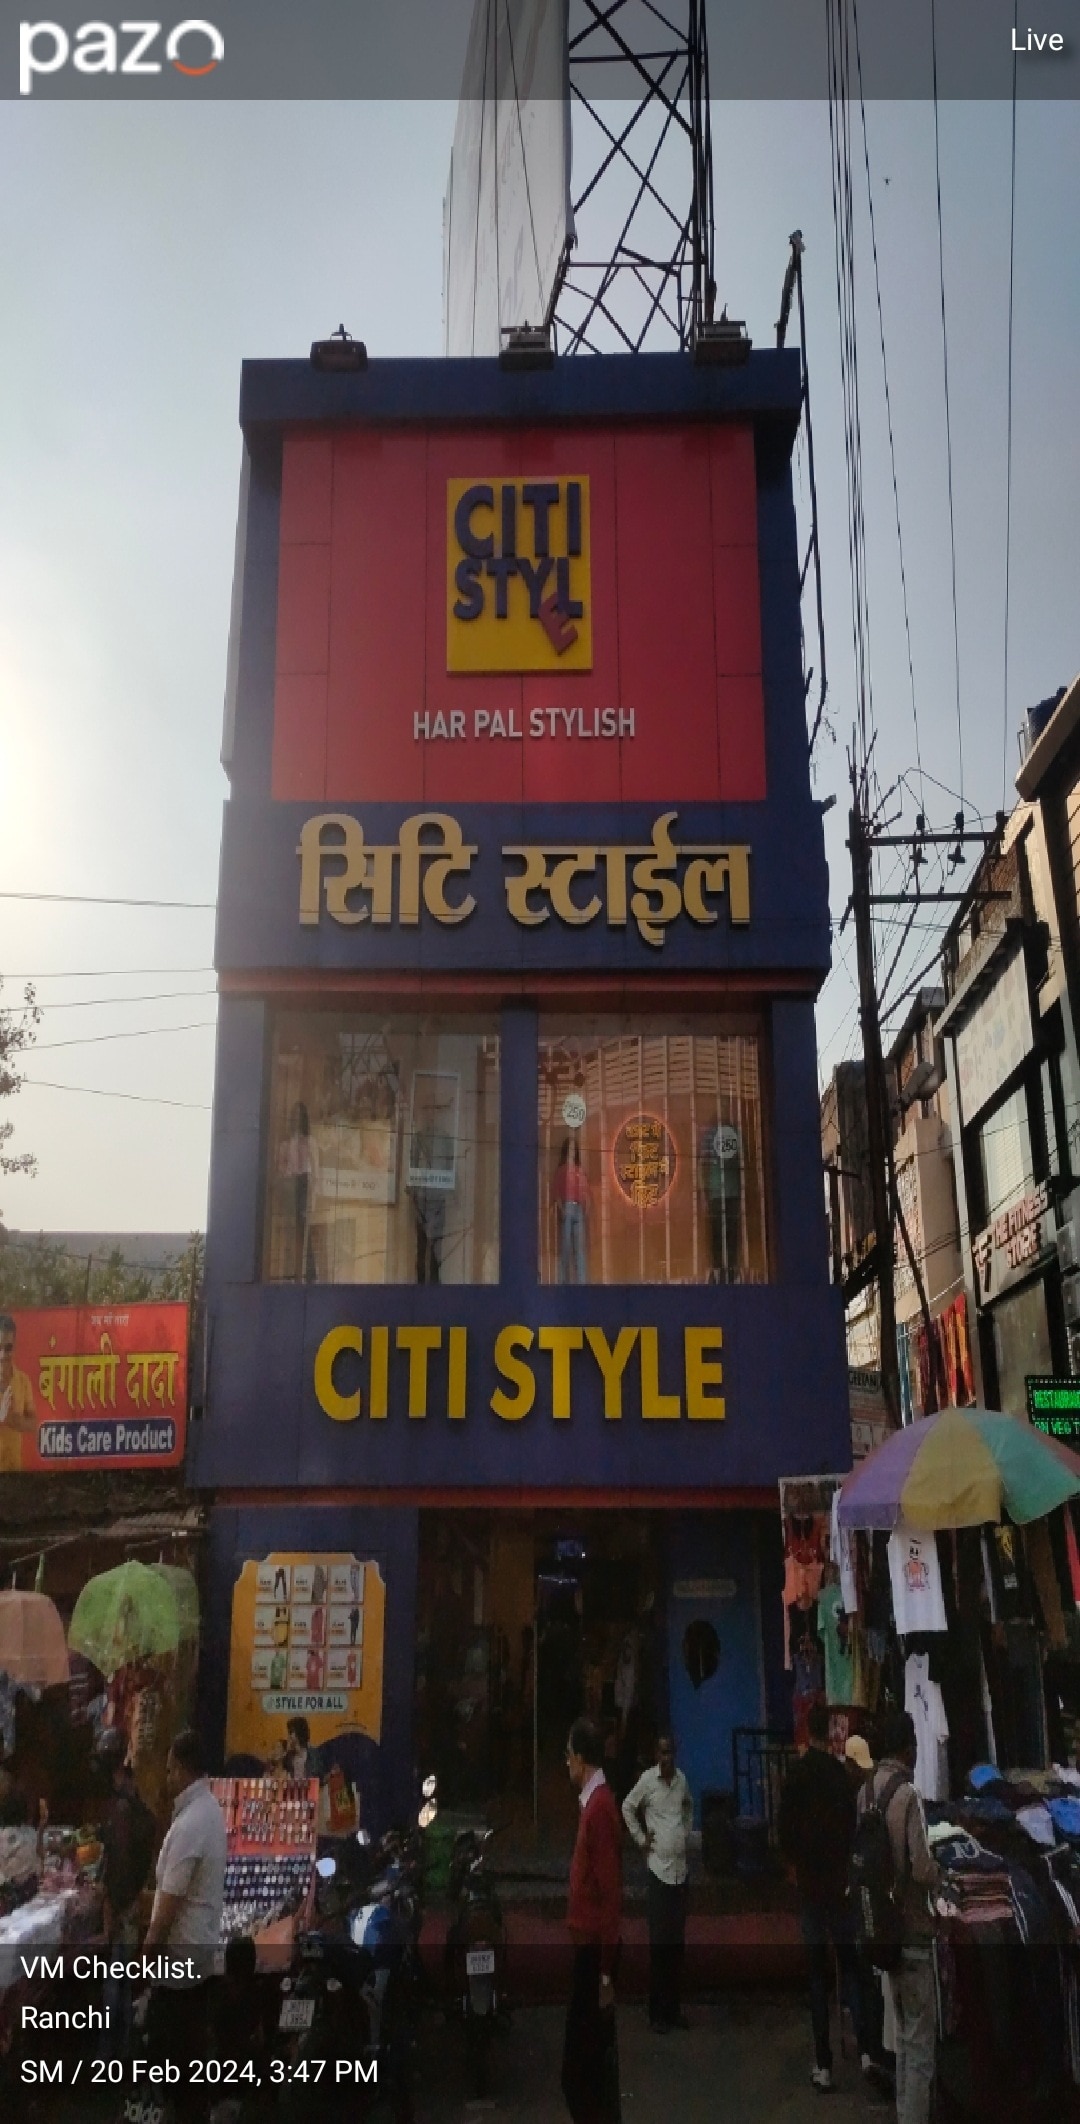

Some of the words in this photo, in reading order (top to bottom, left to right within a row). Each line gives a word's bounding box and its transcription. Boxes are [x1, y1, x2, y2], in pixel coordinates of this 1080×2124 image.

[453, 482, 582, 560] CITI
[413, 709, 466, 740] HAR
[474, 708, 523, 738] PAL
[529, 706, 636, 738] STYLISH
[295, 813, 478, 926] सिटि
[502, 811, 752, 948] स्टाईल
[39, 1332, 120, 1410] बंगाली
[126, 1352, 180, 1408] दादा
[314, 1325, 468, 1421] CITI
[490, 1325, 725, 1421] STYLE
[40, 1427, 73, 1454] Kids
[77, 1425, 112, 1453] Care
[115, 1423, 173, 1451] Product
[305, 1696, 324, 1709] FOR
[326, 1695, 343, 1709] ALL
